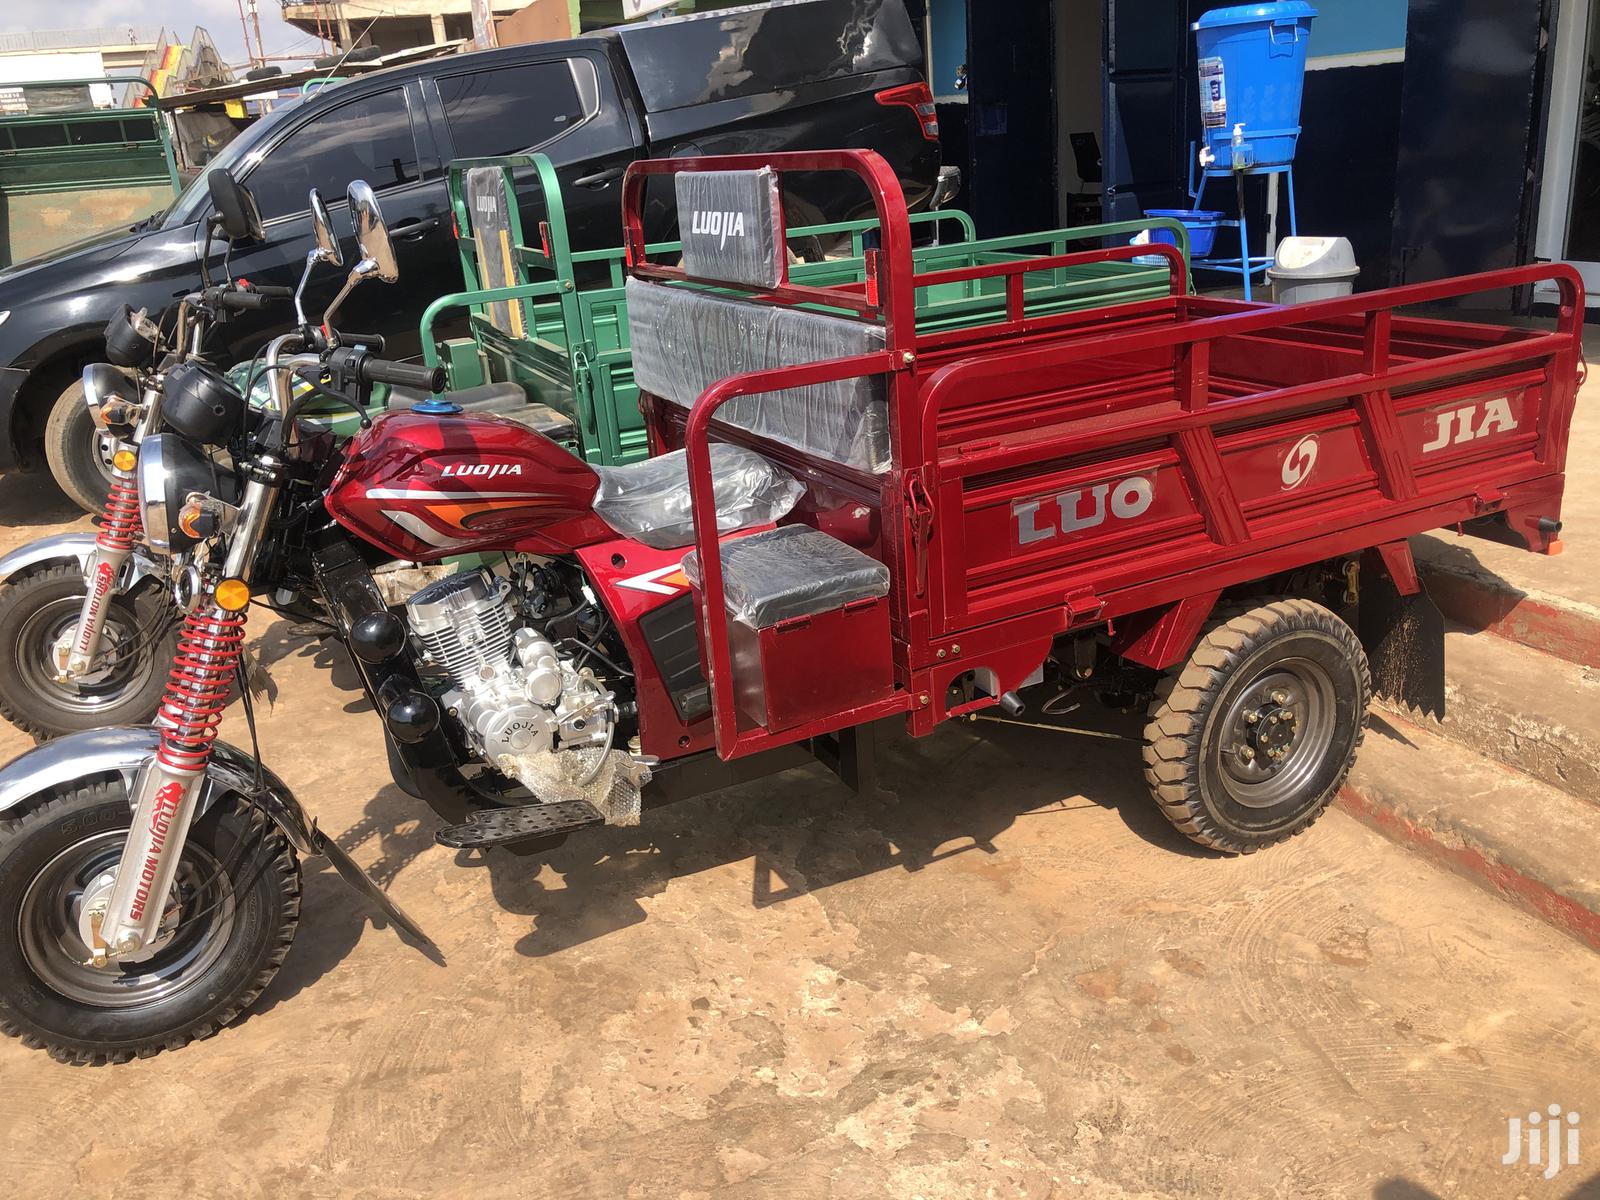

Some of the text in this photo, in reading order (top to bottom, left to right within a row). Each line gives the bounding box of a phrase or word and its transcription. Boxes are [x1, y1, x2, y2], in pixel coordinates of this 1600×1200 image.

[692, 211, 745, 251] LUOJIA
[441, 464, 522, 480] LUOJIA
[1013, 397, 1518, 545] LUO JIA
[79, 573, 108, 651] LUOJIA MOTORS
[502, 722, 539, 743] LUOJIA
[129, 799, 176, 921] LUOJIA MOTORS
